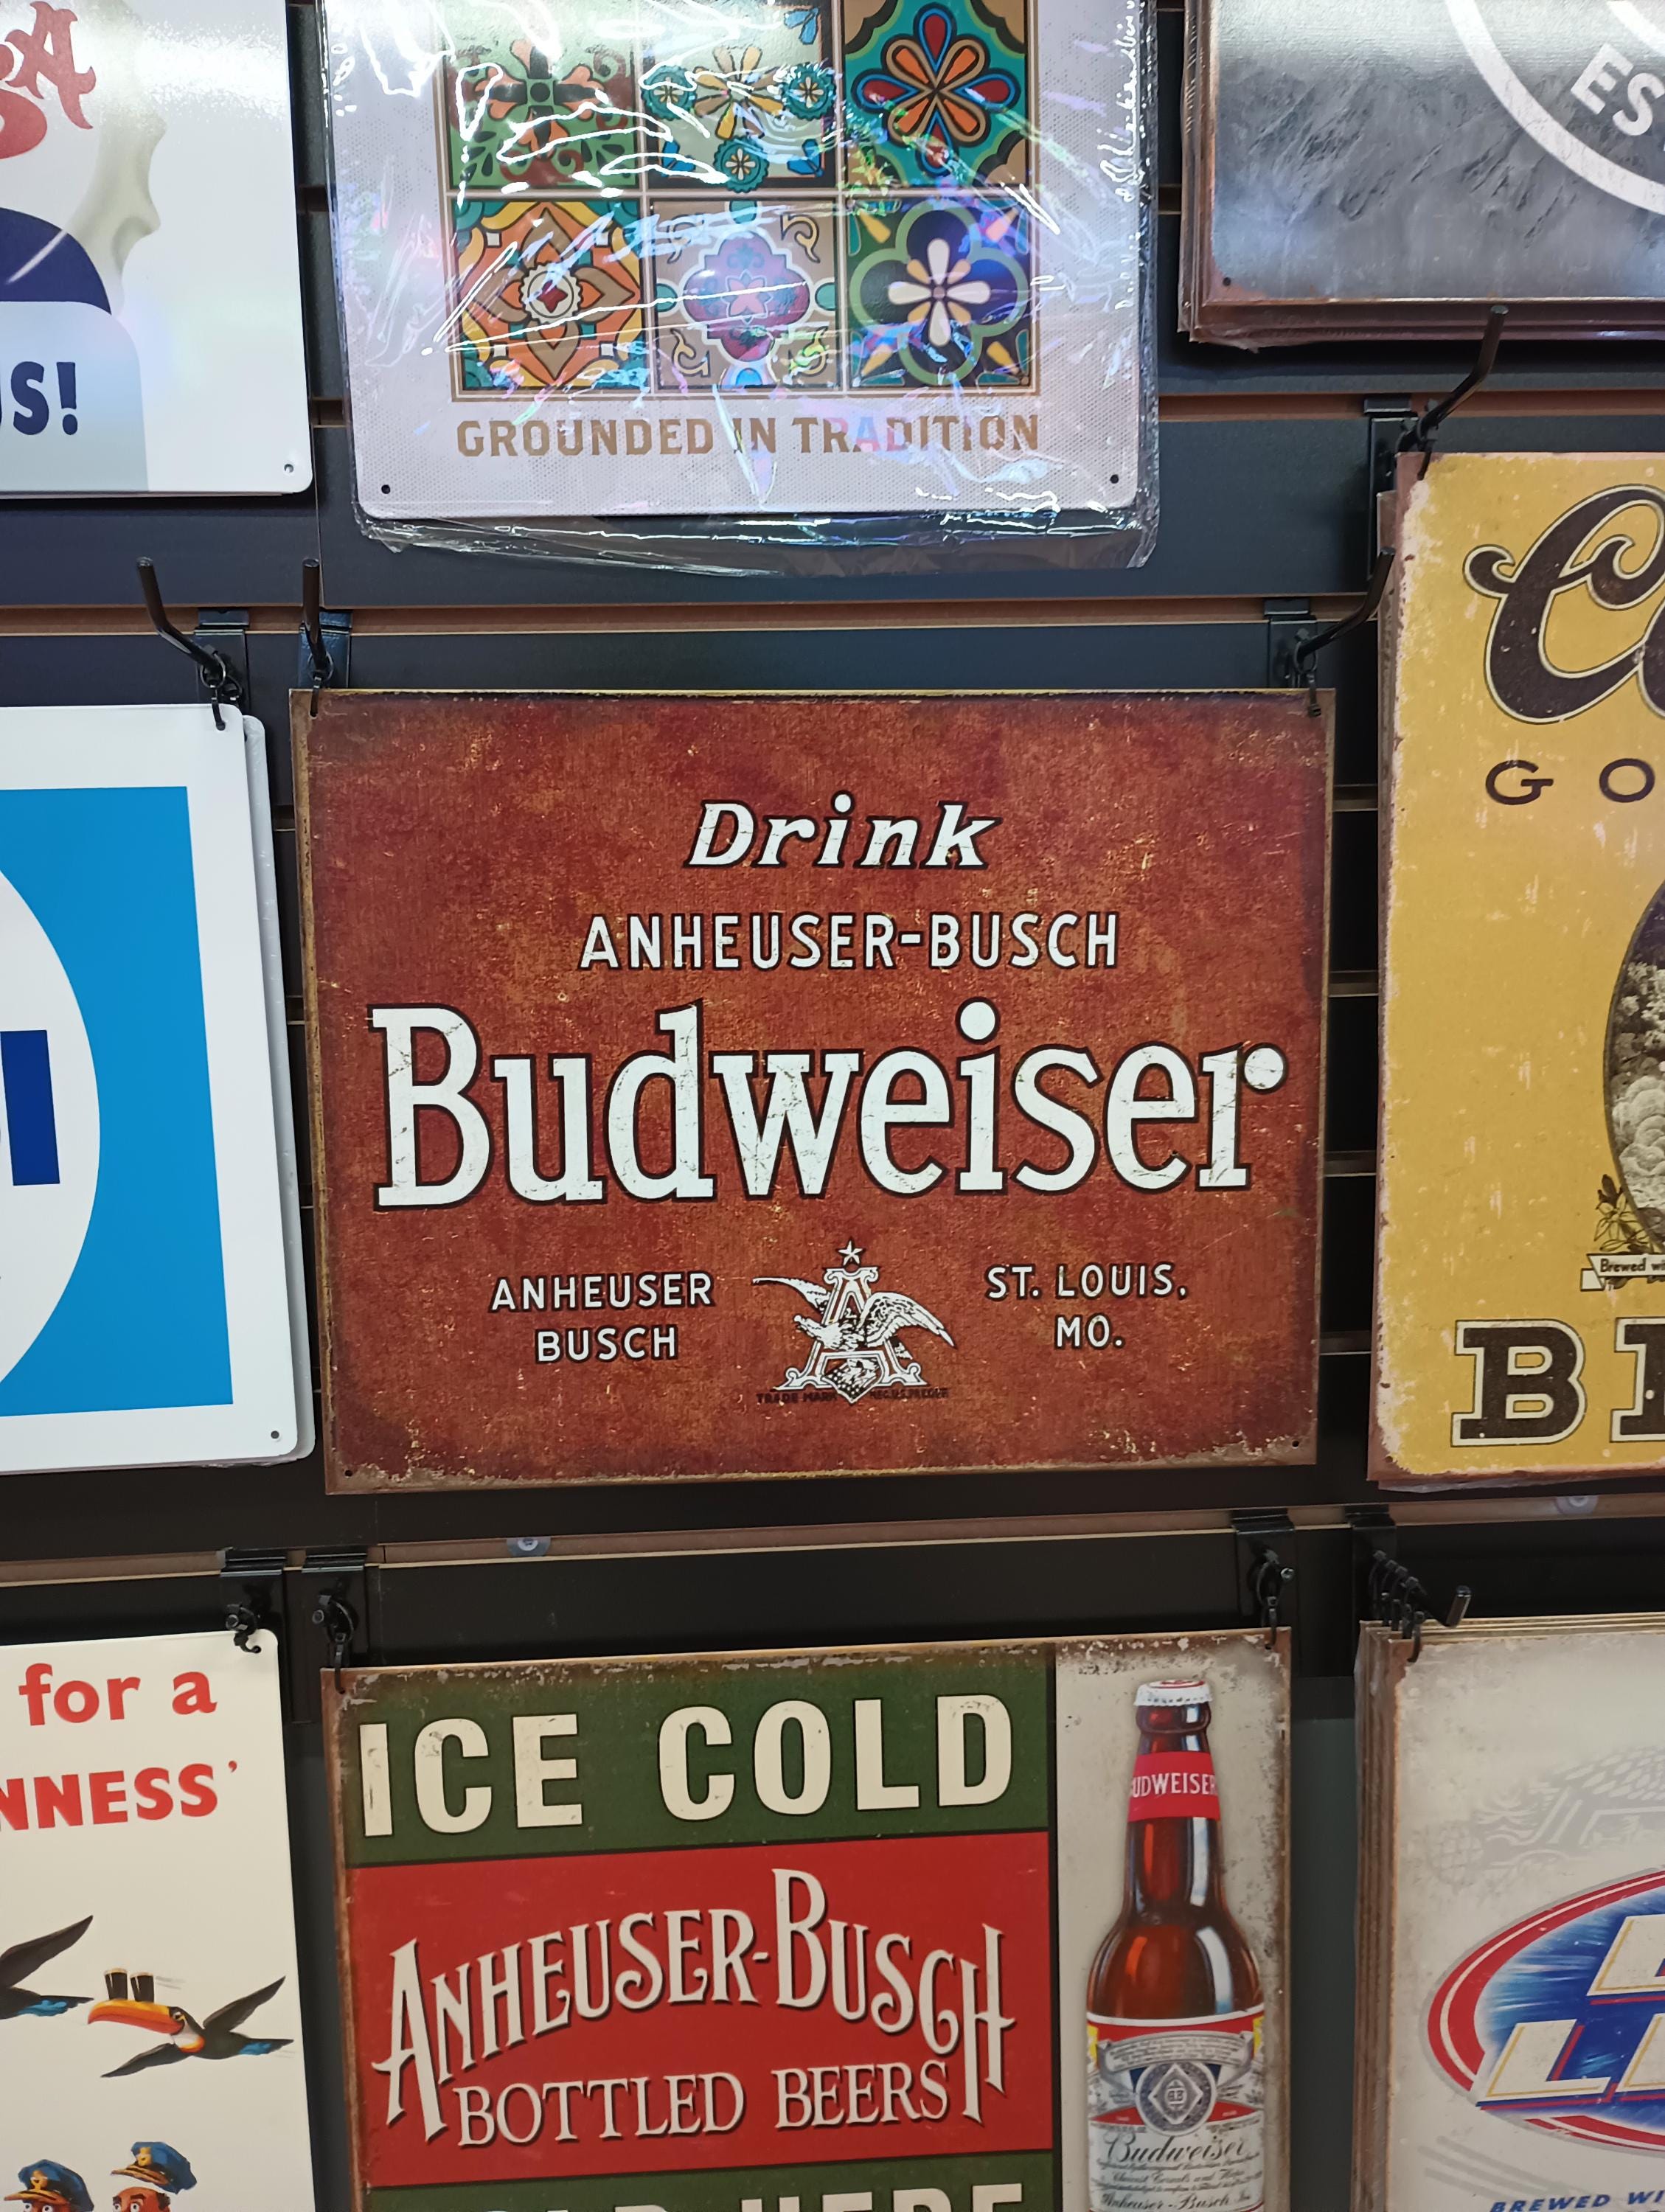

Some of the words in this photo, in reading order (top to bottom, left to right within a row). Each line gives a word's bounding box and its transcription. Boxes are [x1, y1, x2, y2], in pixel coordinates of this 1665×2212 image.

[0, 361, 79, 436] S!
[456, 417, 714, 458] GROUNDED
[732, 416, 776, 453] IN
[791, 414, 1039, 453] TRADITION
[685, 790, 1003, 871] Drink
[580, 911, 1120, 972] ANHEUSER-BUSCH
[369, 998, 1288, 1211] Budweiser
[985, 1264, 1043, 1301] ST.
[1600, 1257, 1647, 1273] Brewed
[490, 1271, 715, 1314] ANHEUSER
[534, 1326, 680, 1363] BUSCH
[1054, 1314, 1124, 1351] MO.
[18, 1663, 141, 1726] for
[171, 1671, 218, 1715] a
[358, 1713, 583, 1837] ICE
[658, 1694, 1013, 1821] COLD
[454, 2072, 745, 2148] BOTTLED
[772, 2060, 949, 2131] BEERS
[1103, 2131, 1246, 2162] Budweiser
[1490, 2194, 1610, 2212] BREWED
